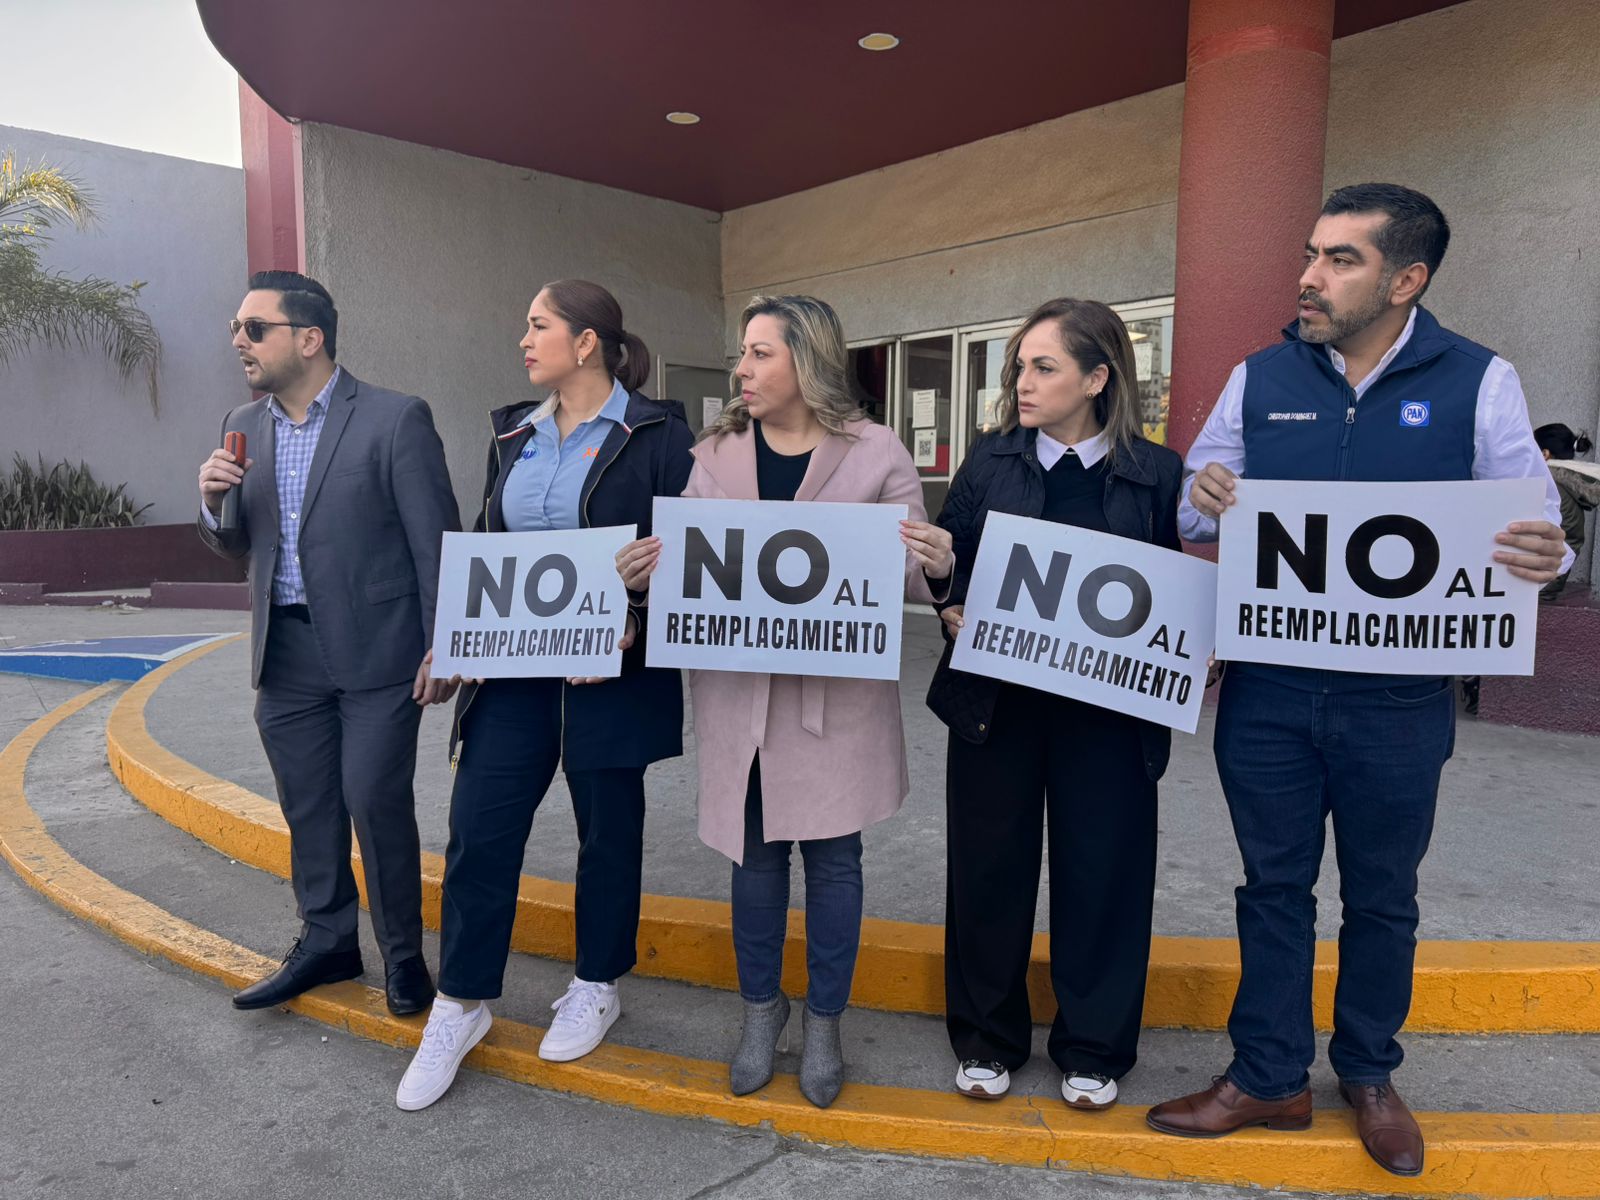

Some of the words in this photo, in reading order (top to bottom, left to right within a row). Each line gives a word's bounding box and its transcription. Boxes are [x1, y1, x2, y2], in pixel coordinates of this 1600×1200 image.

[1407, 408, 1424, 419] PAN
[466, 553, 577, 618] NO
[577, 591, 611, 616] AL
[683, 526, 829, 605] NO
[833, 579, 878, 607] AL
[1256, 512, 1440, 599] NO
[1445, 567, 1505, 599] AL
[667, 612, 886, 655] REEMPLACAMIENTO
[996, 543, 1152, 638] NO
[1147, 624, 1191, 660] AL
[1239, 602, 1515, 649] REEMPLACAMIENTO
[450, 628, 614, 658] REEMPLACAMIENTO
[972, 619, 1191, 706] REEMPLACAMIENTO
